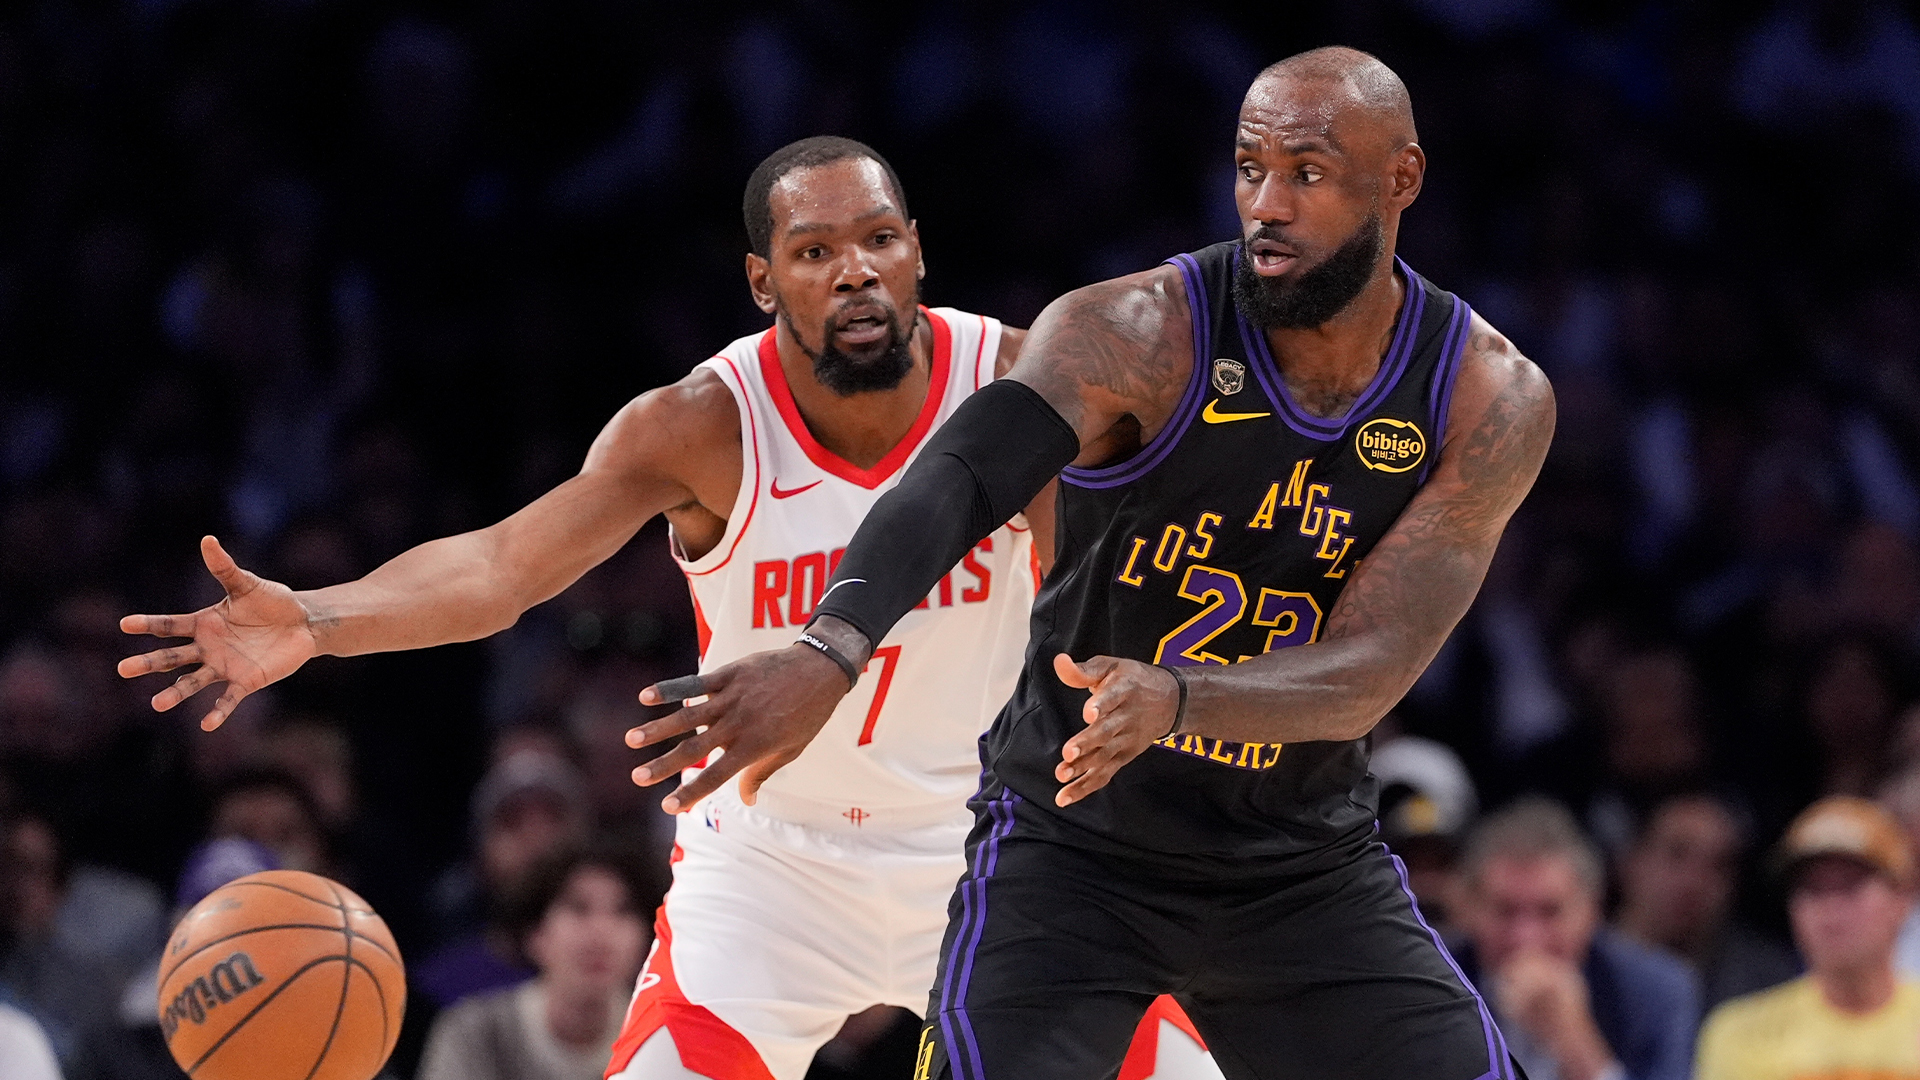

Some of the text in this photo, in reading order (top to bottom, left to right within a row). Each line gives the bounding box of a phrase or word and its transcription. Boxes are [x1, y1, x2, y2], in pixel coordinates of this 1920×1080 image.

[1217, 361, 1242, 370] LEGACY
[1362, 431, 1421, 458] bibigo
[1371, 449, 1396, 461] 비비고
[1116, 458, 1361, 588] LOS ANGEL
[752, 536, 994, 629] ROTS
[1153, 564, 1323, 666] 23
[857, 645, 902, 747] 7
